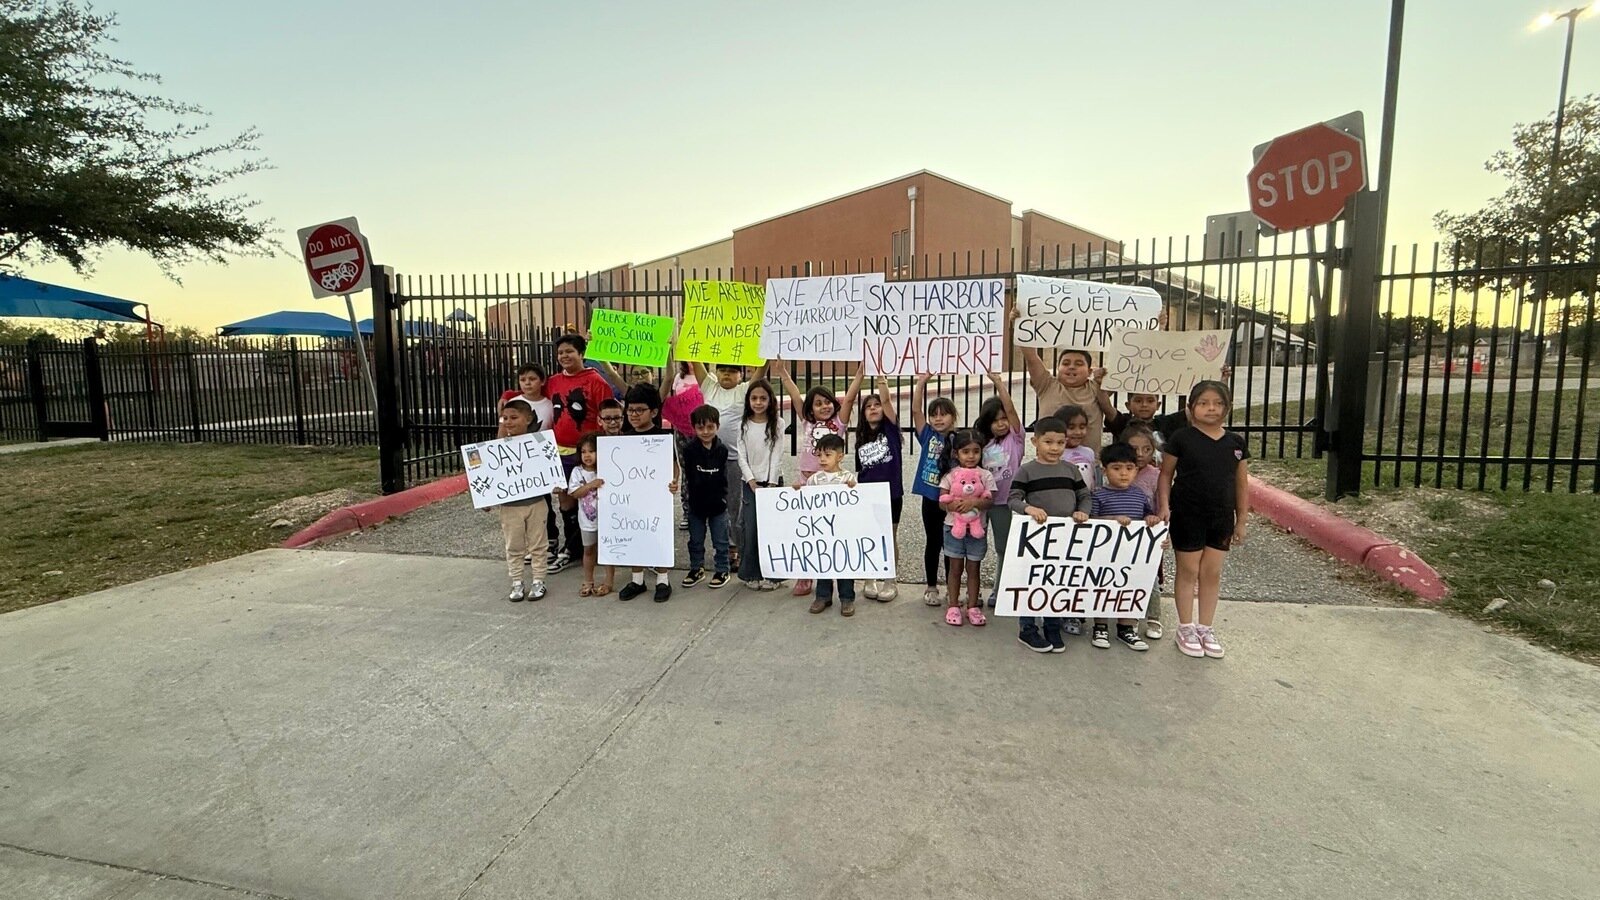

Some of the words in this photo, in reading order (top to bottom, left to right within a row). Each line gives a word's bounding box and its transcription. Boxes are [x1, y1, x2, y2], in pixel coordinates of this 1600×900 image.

[1256, 150, 1353, 208] STOP
[308, 241, 324, 254] DO
[330, 233, 352, 249] NOT
[684, 281, 711, 302] WE
[718, 282, 741, 302] ARE
[770, 278, 809, 309] WE
[817, 275, 866, 304] ARE
[865, 284, 907, 312] SKY
[913, 280, 1004, 311] HARBOUR
[1050, 284, 1072, 294] DE
[1088, 286, 1110, 294] LA
[596, 309, 627, 324] PLEASE
[634, 314, 657, 327] KEEP
[690, 305, 724, 322] THAN
[732, 305, 761, 321] JUST
[763, 310, 793, 328] SKY
[795, 304, 860, 325] HARBOUR
[1027, 296, 1138, 317] ESCUELA
[597, 326, 617, 338] OUR
[620, 326, 656, 343] SCHOOL
[687, 325, 697, 339] A
[706, 323, 761, 339] NUMBER
[864, 314, 900, 336] NOS
[908, 311, 997, 336] PERTENESE
[1017, 319, 1065, 345] SKY
[610, 341, 643, 357] OPEN
[1119, 331, 1187, 361] Save
[1117, 357, 1152, 374] Our
[487, 440, 540, 471] SAVE
[610, 446, 656, 487] Save
[506, 462, 524, 478] MY
[775, 489, 860, 512] Salvemos
[795, 514, 836, 538] SKY
[767, 535, 889, 574] HARBOUR!
[1028, 564, 1132, 588] FRIENDS
[1004, 586, 1147, 614] TOGETHER
